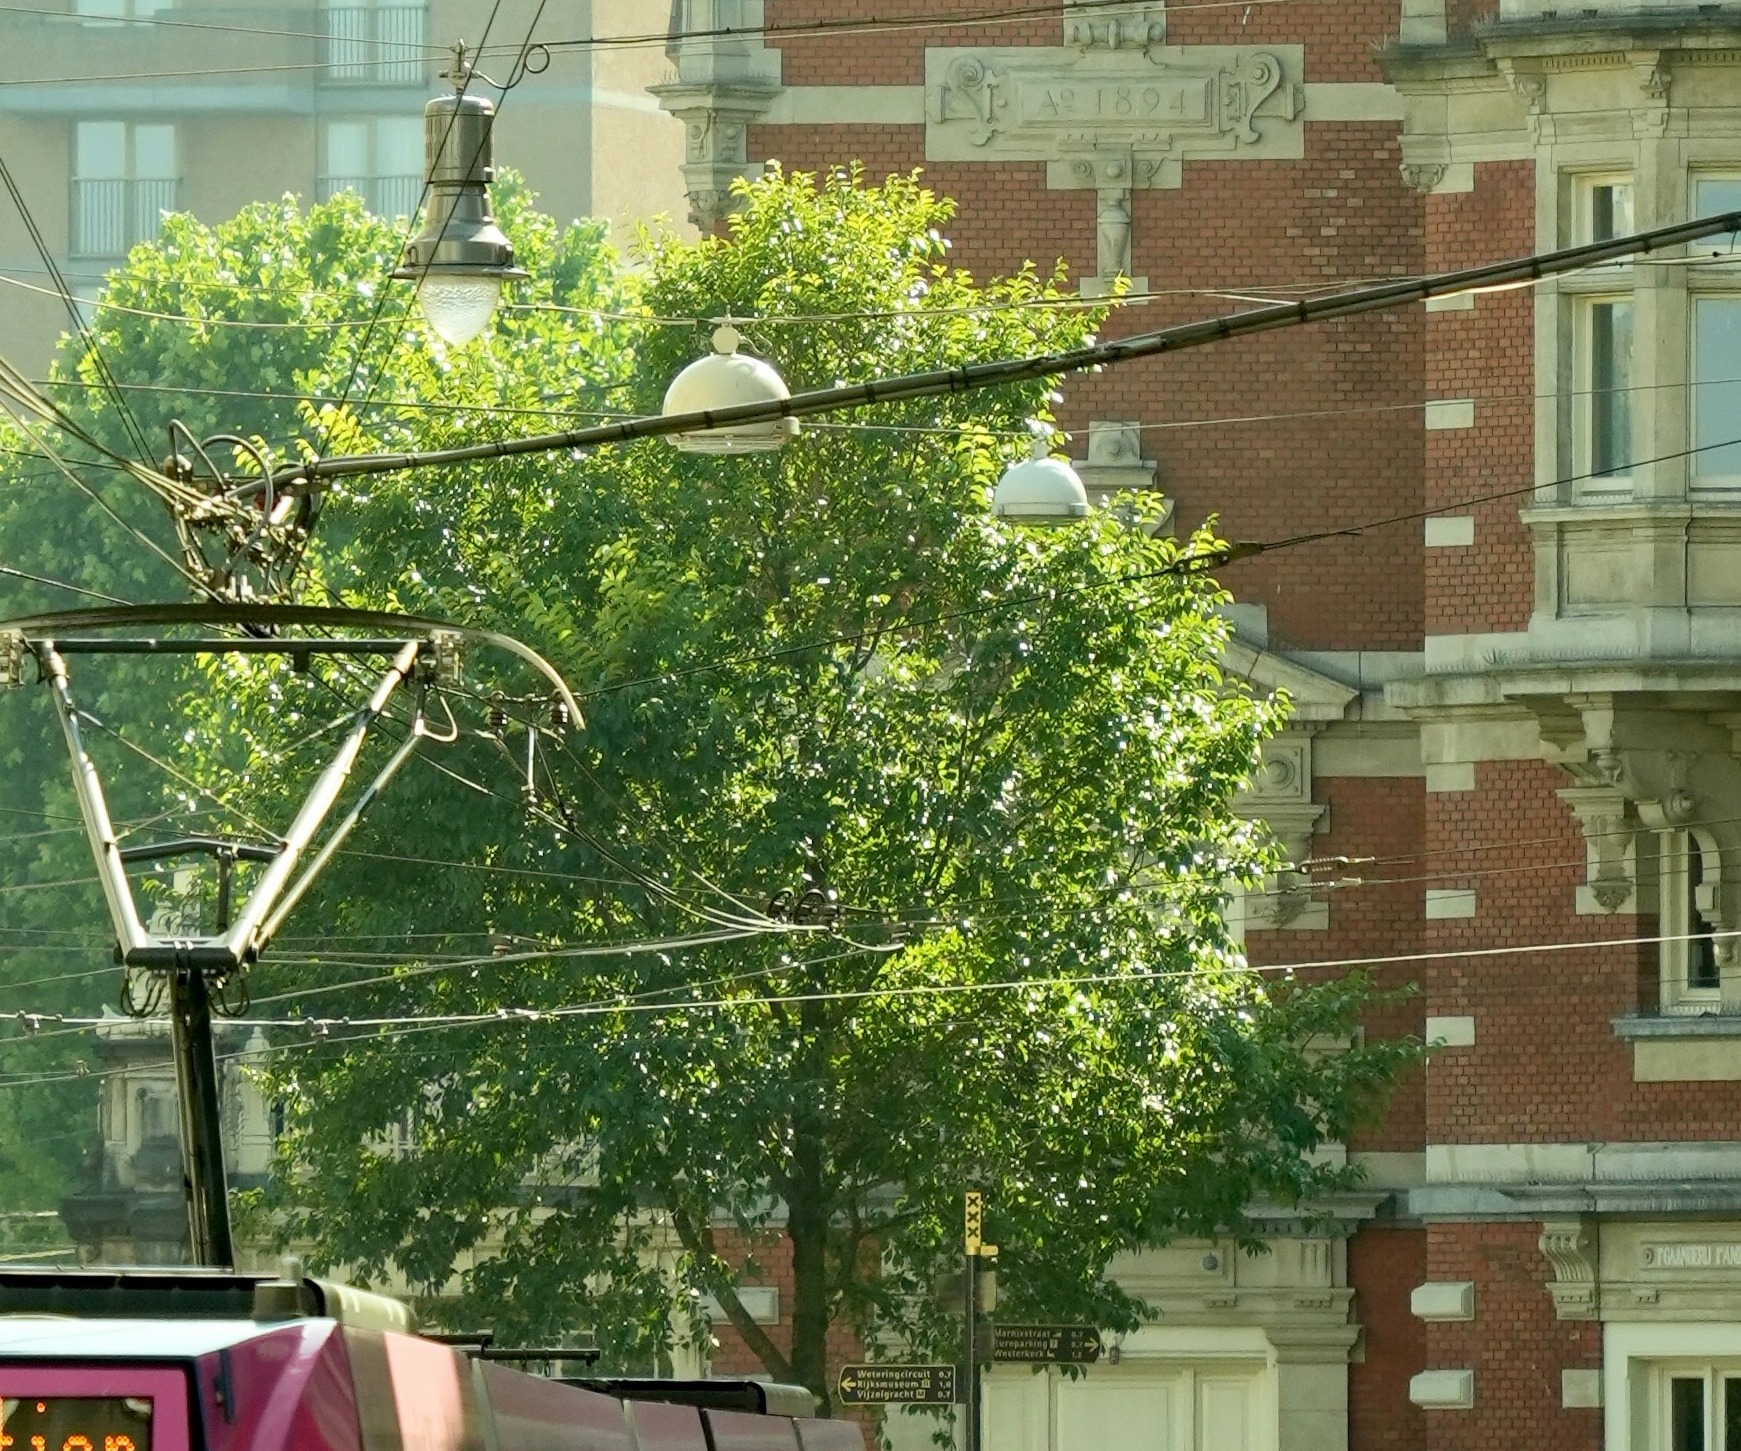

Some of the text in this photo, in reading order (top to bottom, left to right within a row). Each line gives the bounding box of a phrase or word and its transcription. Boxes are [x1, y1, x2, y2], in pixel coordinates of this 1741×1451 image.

[1097, 85, 1186, 115] 1894
[994, 1329, 1050, 1337] Marnixstraat
[994, 1350, 1044, 1358] Westerkerk
[857, 1370, 931, 1379] Weteringcircuit
[857, 1380, 919, 1389] Rijksmuseum
[857, 1390, 914, 1400] Vijzelgracht
